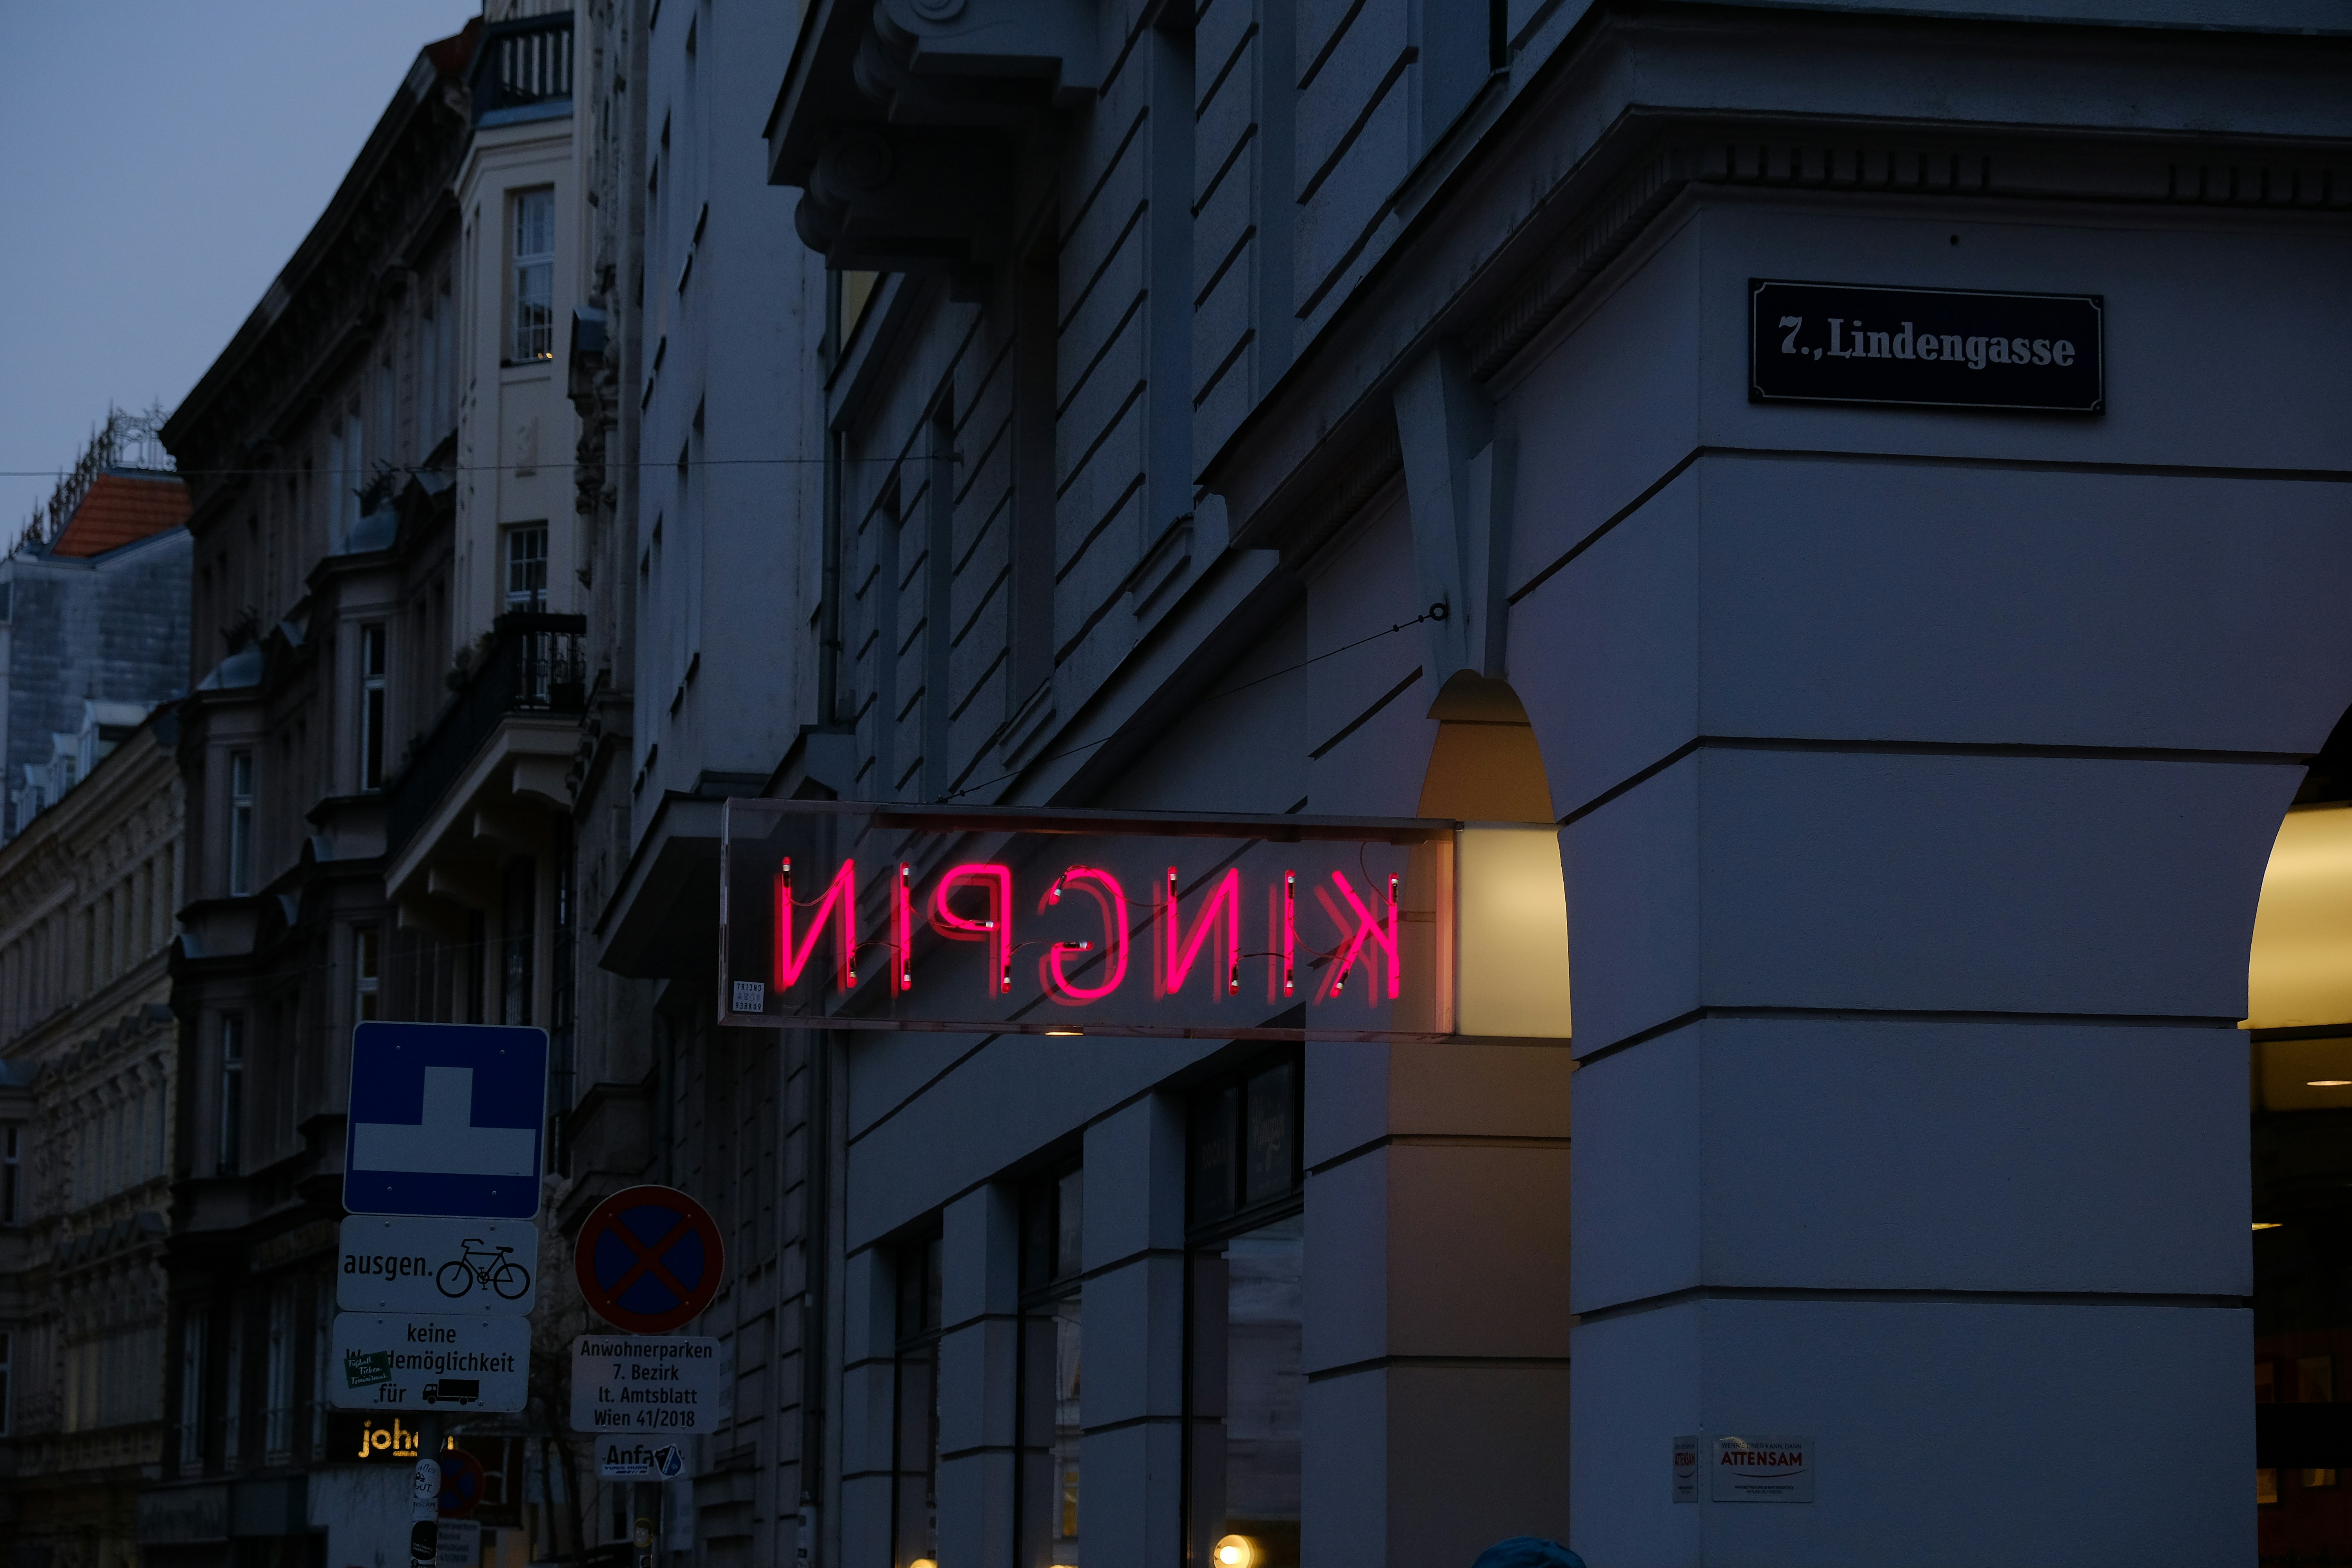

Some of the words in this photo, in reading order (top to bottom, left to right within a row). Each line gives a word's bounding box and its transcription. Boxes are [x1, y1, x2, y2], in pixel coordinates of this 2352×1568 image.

[343, 1255, 433, 1281] ausgen.
[407, 1323, 456, 1343] keine
[581, 1340, 712, 1360] Anwohnerparken
[613, 1364, 625, 1379] 7.
[632, 1364, 679, 1380] Bezirk
[379, 1384, 406, 1403] für
[599, 1387, 614, 1403] lt.
[620, 1387, 697, 1403] Amtsblatt
[594, 1409, 630, 1426] Wien
[636, 1408, 695, 1428] 41/2018
[1720, 1451, 1802, 1466] ATTENSAM
